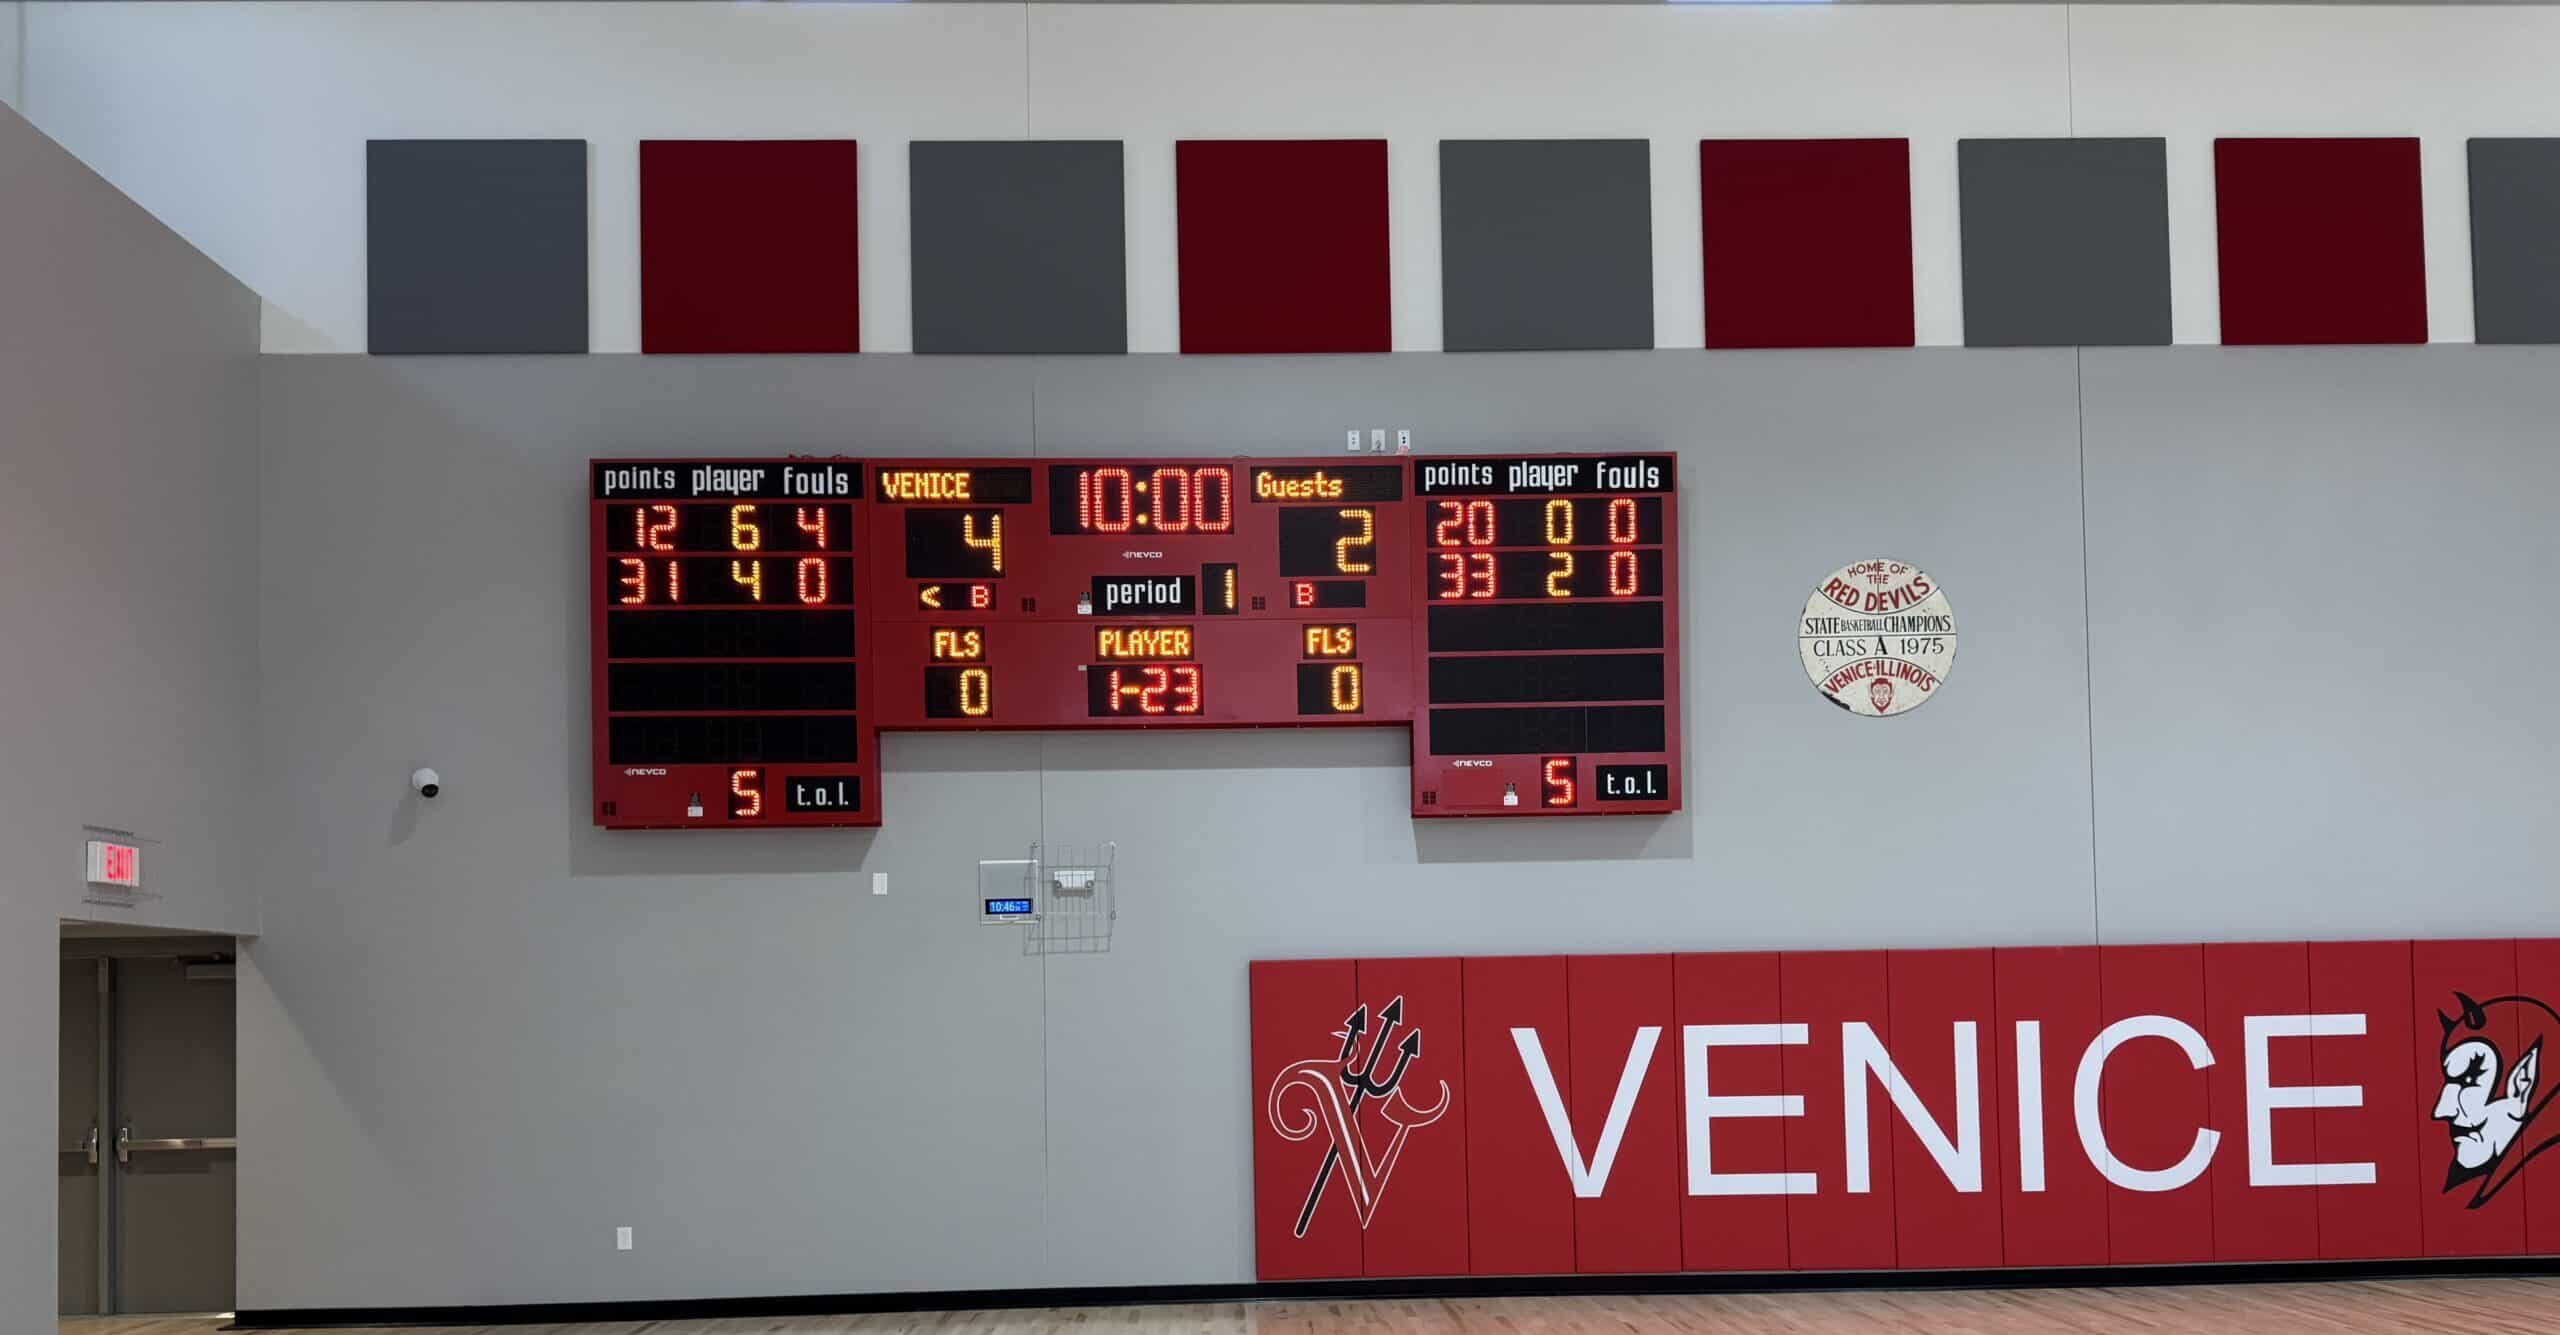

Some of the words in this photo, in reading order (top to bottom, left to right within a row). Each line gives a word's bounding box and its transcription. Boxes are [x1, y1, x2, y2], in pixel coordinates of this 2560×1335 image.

[604, 466, 676, 496] points
[691, 465, 765, 496] player
[783, 466, 849, 495] fouls
[881, 471, 971, 500] VENICE
[1255, 470, 1344, 499] Guests
[1424, 462, 1493, 491] points
[1508, 461, 1579, 492] player
[1597, 460, 1659, 489] fouls
[1078, 467, 1231, 532] 10:00
[635, 504, 678, 550] 12
[731, 504, 760, 550] 6
[797, 506, 826, 549] 4
[1336, 508, 1373, 573] 2
[1436, 500, 1495, 547] 20
[1546, 499, 1573, 544] 0
[1609, 499, 1636, 544] 0
[963, 514, 1001, 571] 4
[620, 556, 678, 604] 31
[731, 559, 761, 601] 4
[797, 556, 828, 604] 0
[1223, 567, 1234, 610] 1
[1439, 551, 1496, 599] 33
[1546, 550, 1574, 597] 2
[1608, 550, 1637, 597] 0
[1847, 562, 1885, 578] HOME
[1889, 563, 1908, 575] OF
[1866, 574, 1890, 585] THE
[971, 586, 989, 607] B
[1106, 576, 1182, 611] period
[1295, 583, 1313, 606] B
[1823, 577, 1861, 608] RED
[1864, 575, 1930, 612] DEVILS
[1099, 629, 1190, 657] PLAYER
[1307, 627, 1354, 655] FLS
[1805, 617, 1841, 635] STATE
[1840, 619, 1885, 632] BASKETBALL
[1884, 615, 1951, 633] CHAMPIONS
[933, 630, 981, 658] FLS
[1813, 639, 1867, 657] CLASS
[1874, 635, 1888, 655] A
[1900, 637, 1944, 655] 1975
[959, 668, 989, 715] 0
[1109, 667, 1198, 713] 1-23
[1332, 665, 1359, 712] 0
[731, 769, 760, 816] 5
[1545, 758, 1572, 805] 5
[1510, 1013, 2376, 1199] VENICE
